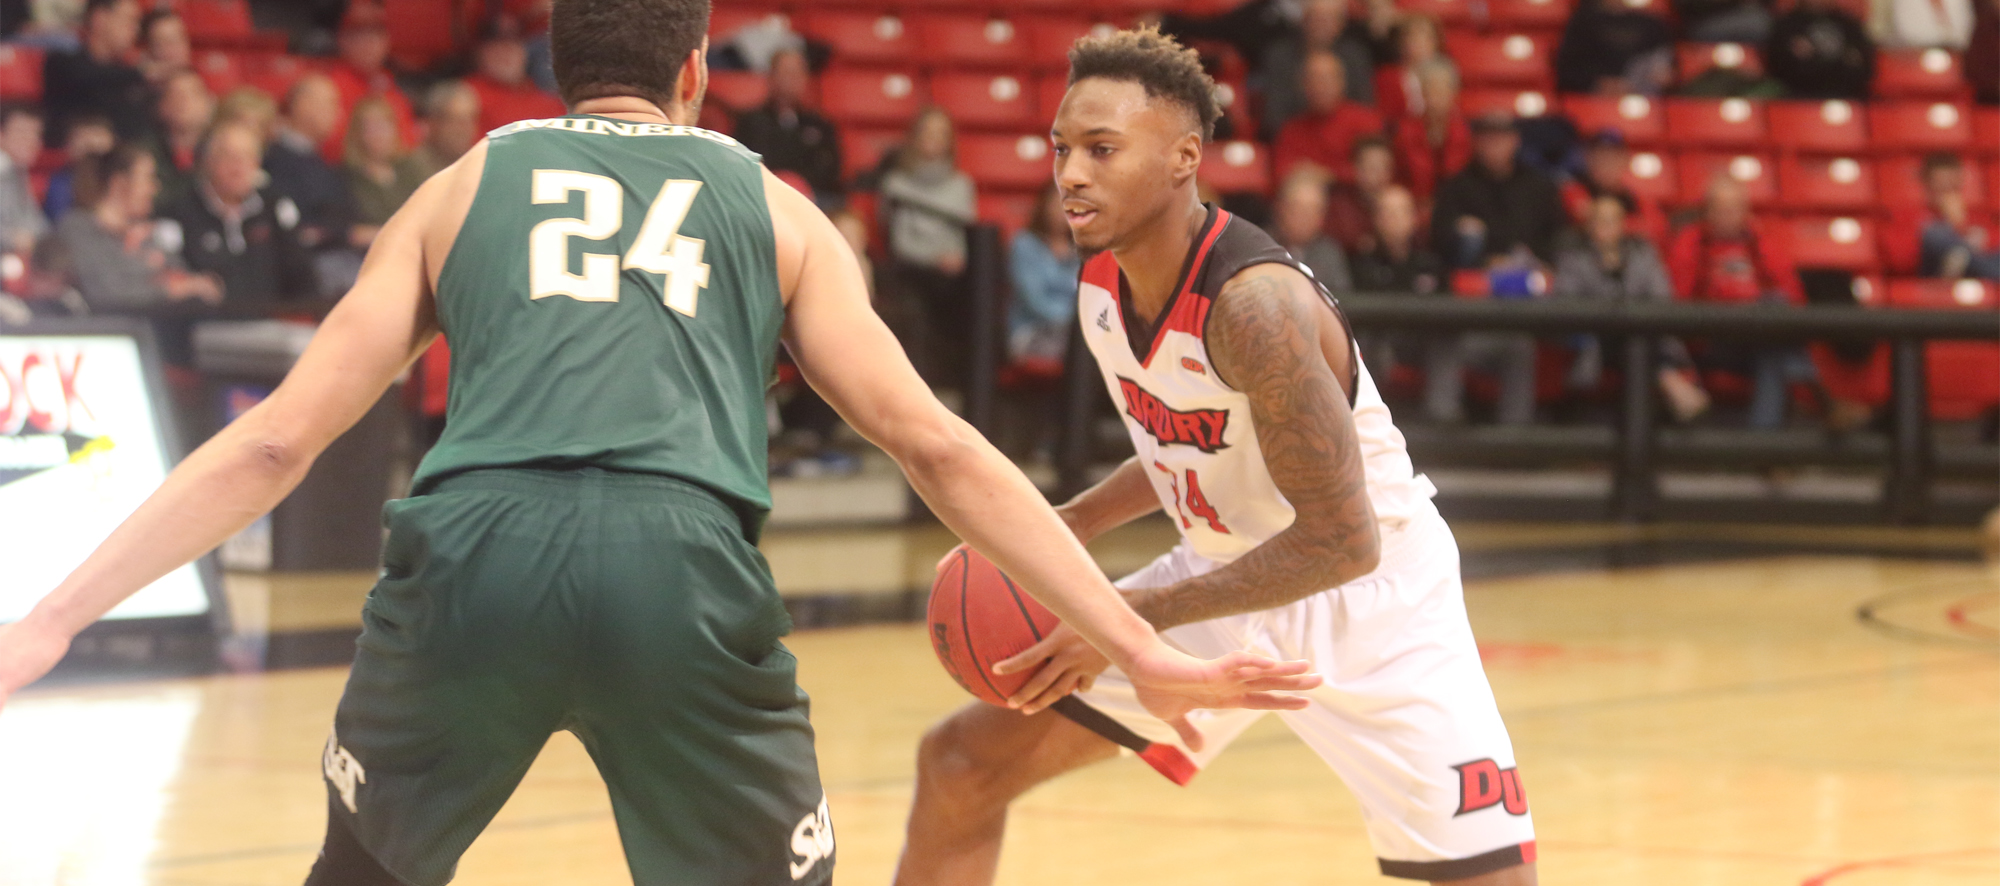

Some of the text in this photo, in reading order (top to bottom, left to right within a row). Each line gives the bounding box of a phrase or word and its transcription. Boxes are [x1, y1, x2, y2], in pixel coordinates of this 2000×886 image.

[511, 117, 737, 147] MINERS
[529, 169, 711, 318] 24
[1115, 373, 1232, 454] DRURY
[1448, 757, 1528, 819] DU
